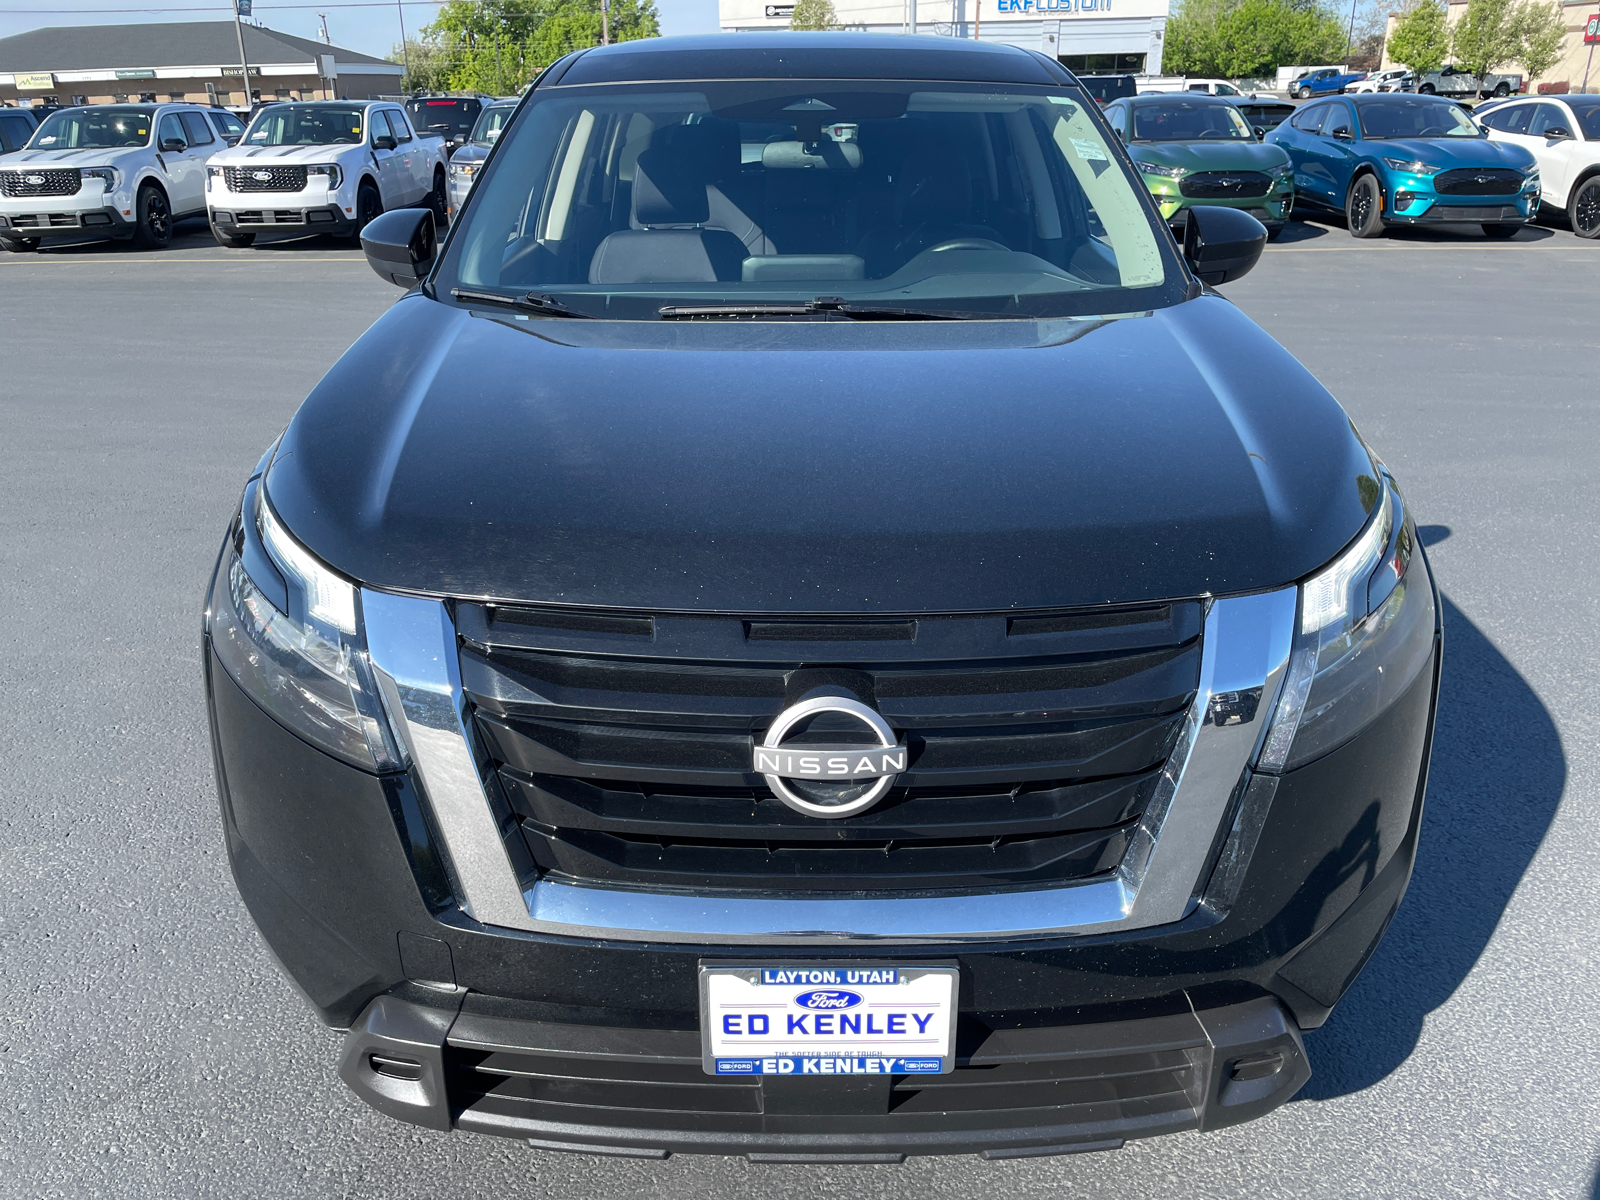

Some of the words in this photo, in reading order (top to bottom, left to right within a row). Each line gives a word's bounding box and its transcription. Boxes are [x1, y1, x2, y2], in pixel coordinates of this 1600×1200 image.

[758, 752, 903, 775] NISSAN
[765, 970, 842, 984] LAYTON,
[846, 970, 894, 983] UTAH
[807, 991, 849, 1009] Ford
[722, 1013, 769, 1035] ED
[786, 1013, 935, 1035] KENLEY
[762, 1059, 794, 1074] ED
[803, 1059, 897, 1074] KENLEY
[920, 1062, 938, 1070] FORD
